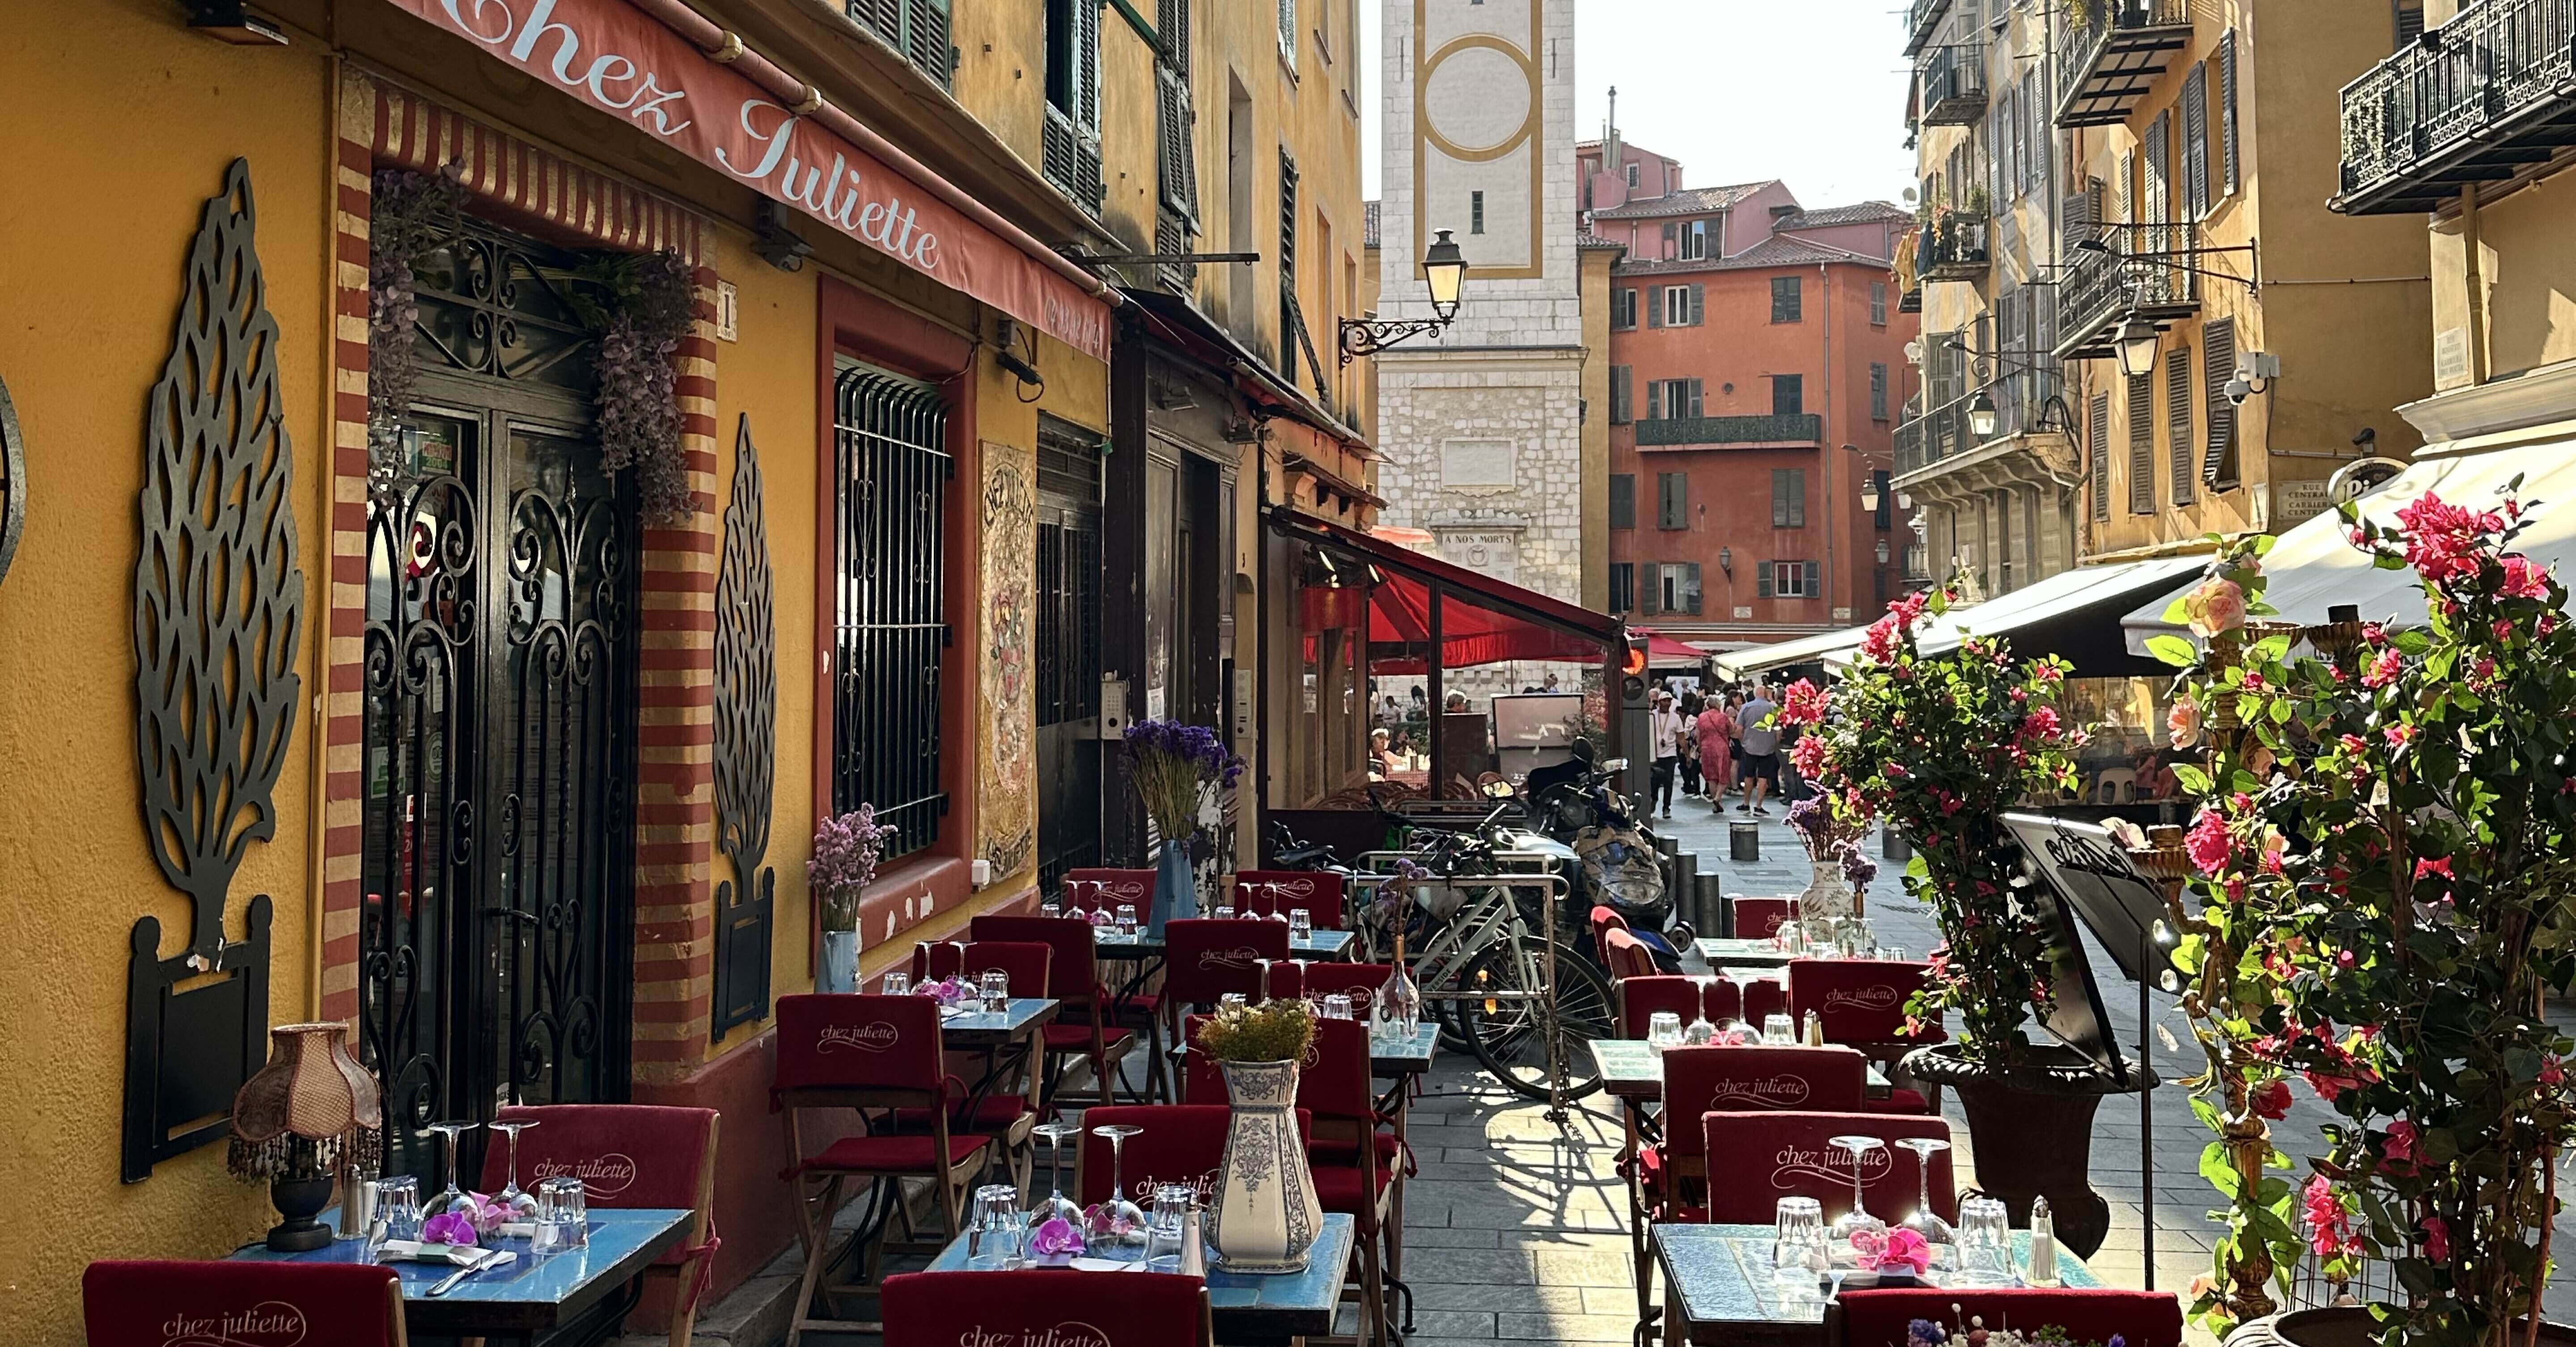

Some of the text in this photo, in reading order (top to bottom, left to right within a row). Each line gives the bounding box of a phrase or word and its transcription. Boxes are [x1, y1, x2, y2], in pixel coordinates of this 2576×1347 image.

[716, 99, 940, 269] Juliette
[1445, 535, 1511, 544] A NOS MORTS
[1826, 987, 1893, 1002] chez juliette
[821, 1024, 894, 1043] chez juliette
[1715, 1078, 1804, 1098] chez juliette
[534, 1158, 631, 1179] chez juliette
[1776, 1145, 1886, 1173] chez julitte
[163, 1310, 300, 1344] chez juliette
[960, 1325, 1015, 1347] chez
